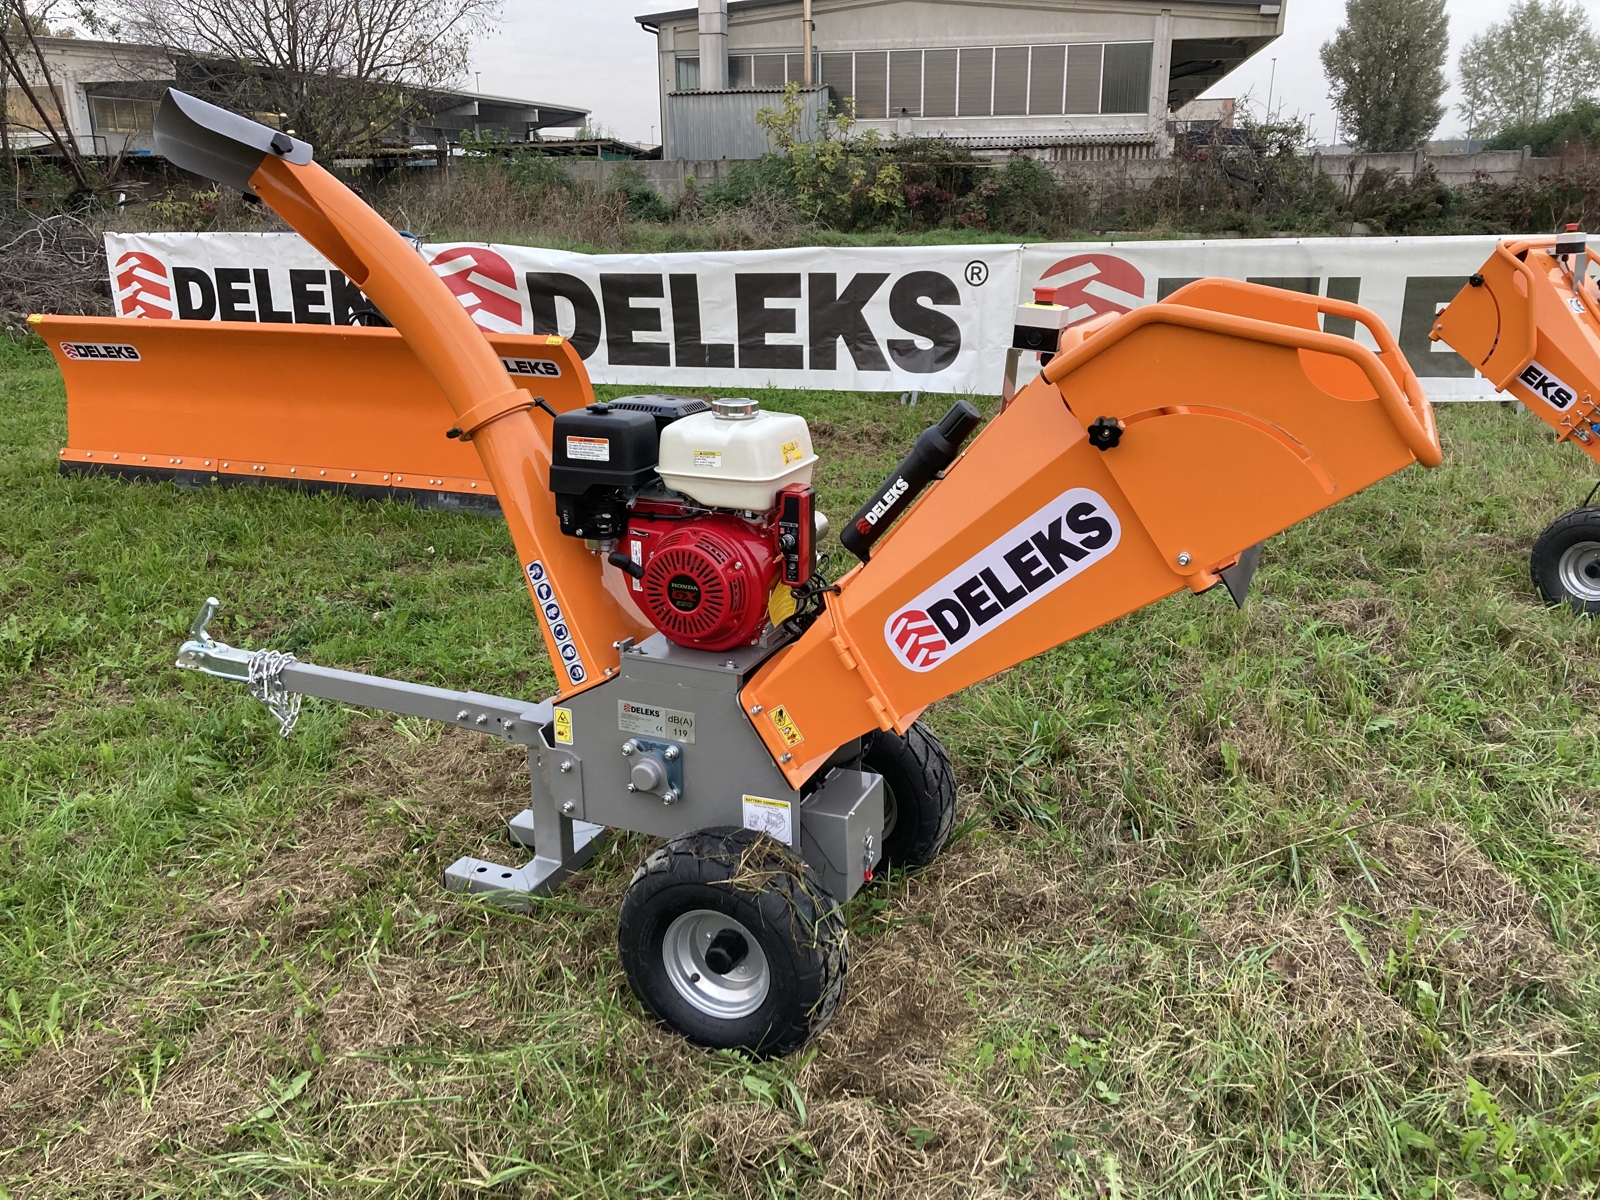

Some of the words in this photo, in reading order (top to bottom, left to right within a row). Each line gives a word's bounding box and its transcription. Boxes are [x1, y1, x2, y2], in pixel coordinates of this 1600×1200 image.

[526, 271, 962, 374] DELEKS
[73, 345, 139, 359] DELEKS
[1518, 365, 1573, 409] EKS
[865, 478, 910, 525] DELEKS
[925, 502, 1113, 645] DELEKS
[671, 582, 699, 591] HONDA
[671, 590, 698, 602] GX
[630, 705, 660, 718] DELEKS
[667, 715, 693, 728] dB(A)
[673, 728, 688, 738] 119
[763, 800, 789, 808] CONNECTION
